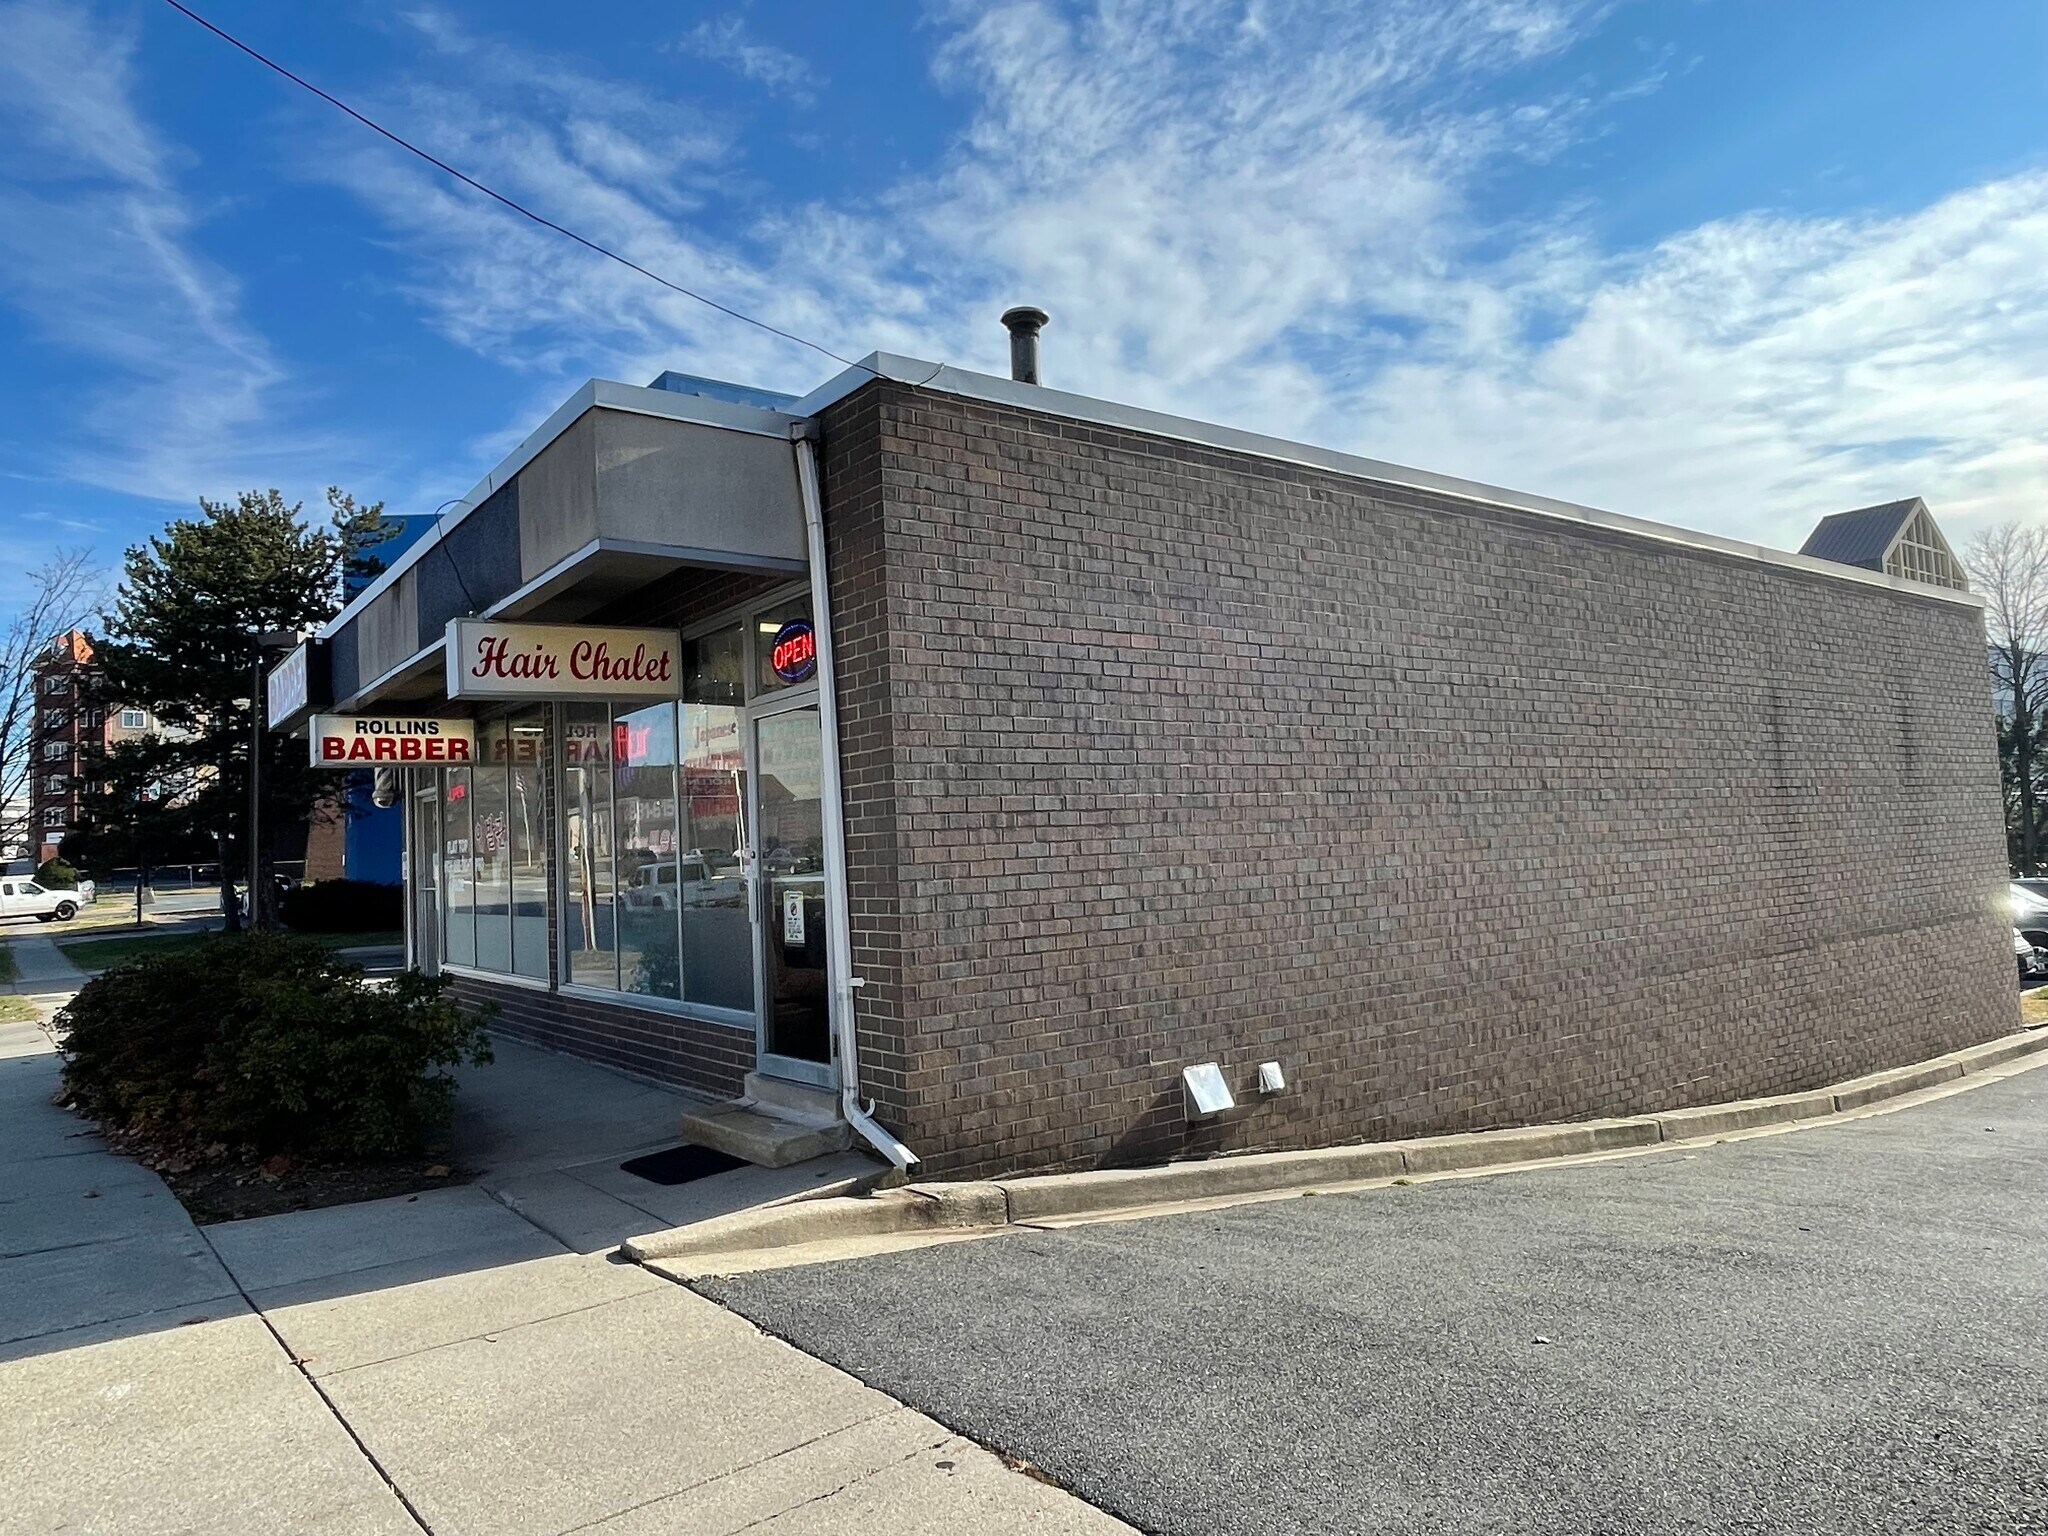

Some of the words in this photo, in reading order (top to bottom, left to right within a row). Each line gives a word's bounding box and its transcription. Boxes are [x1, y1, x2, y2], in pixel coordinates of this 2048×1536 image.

[471, 636, 560, 679] Hair
[570, 640, 671, 682] Chalet
[773, 629, 812, 670] OPEN
[355, 720, 439, 735] ROLLINS
[322, 736, 470, 761] BARBER
